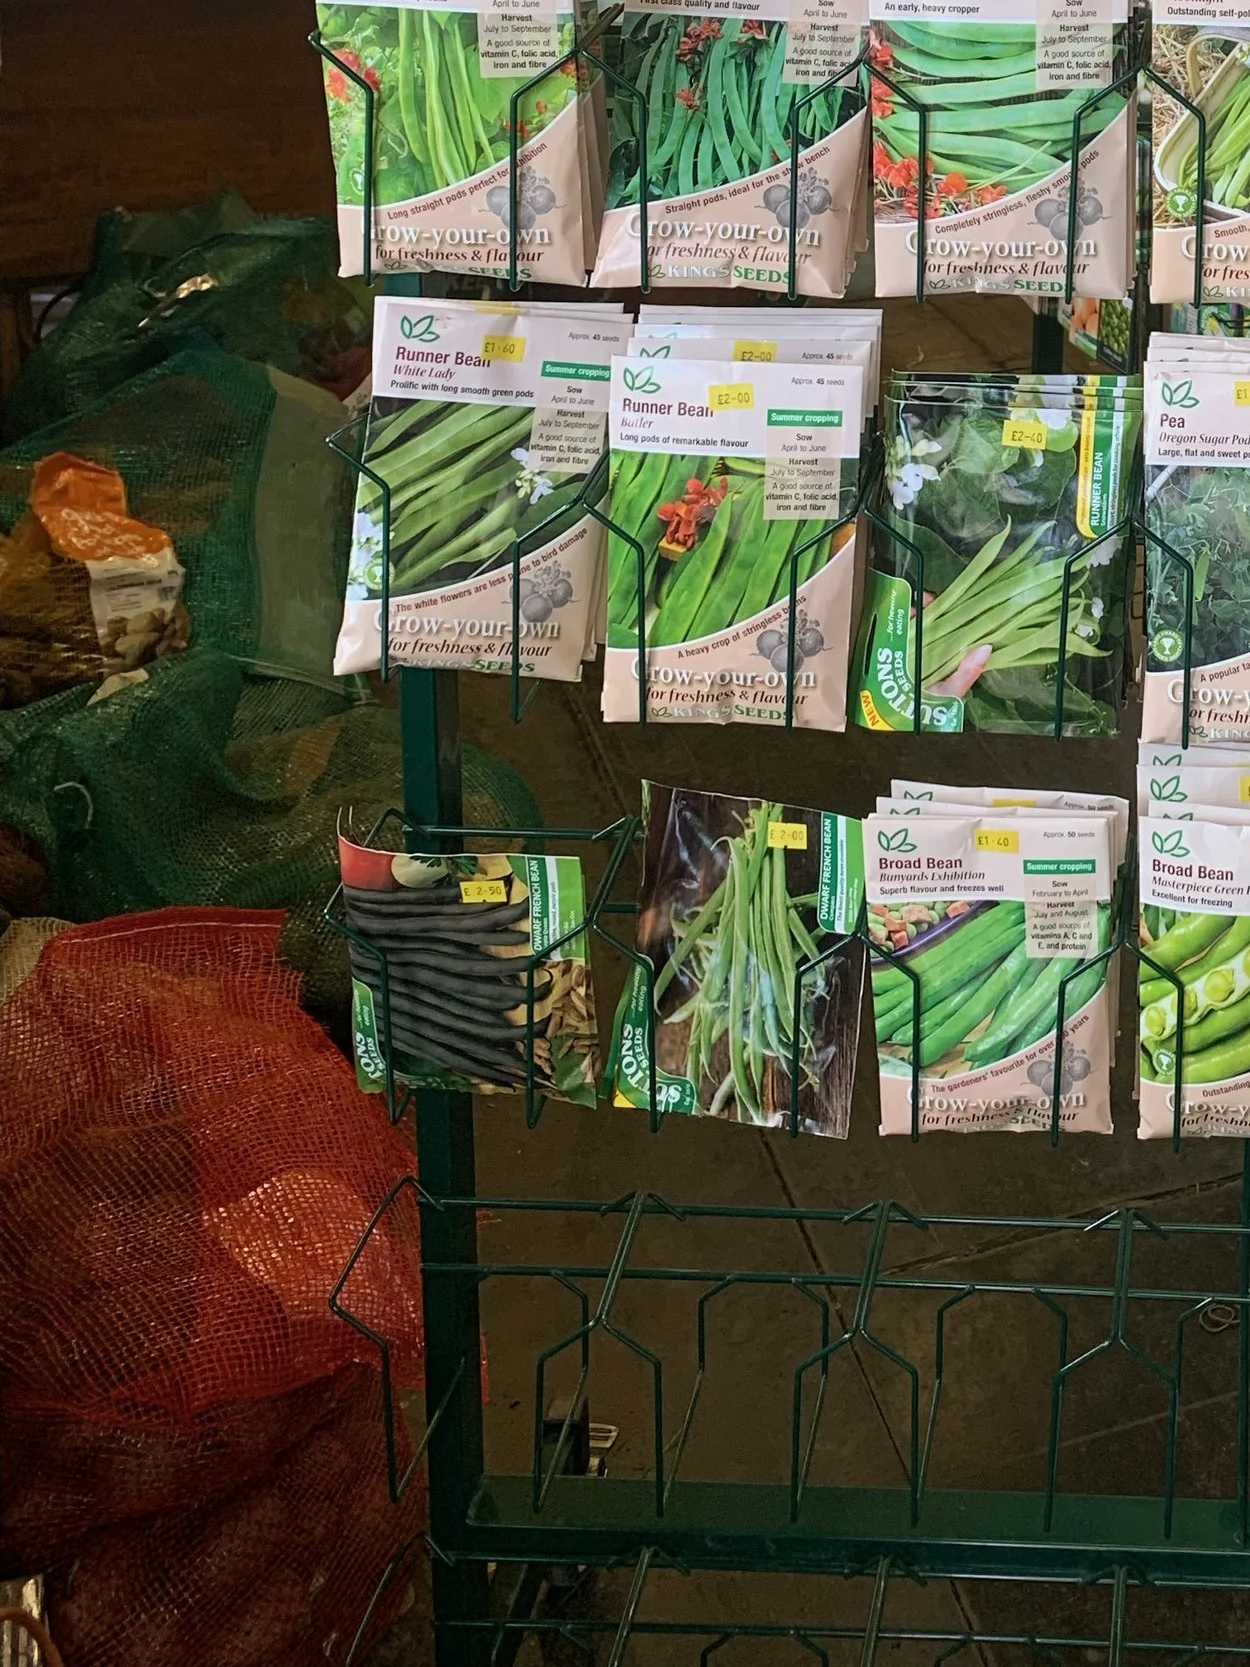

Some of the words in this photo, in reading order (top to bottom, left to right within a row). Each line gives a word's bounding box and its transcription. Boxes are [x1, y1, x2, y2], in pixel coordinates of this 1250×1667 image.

[484, 342, 515, 355] £1-60
[393, 364, 427, 377] White
[428, 367, 456, 382] Lady
[718, 392, 750, 405] £2-00
[1160, 413, 1185, 429] Pea
[1159, 431, 1192, 444] Oregon
[1196, 433, 1227, 446] Sugar
[1230, 433, 1250, 444] Pod
[1158, 447, 1183, 458] Large,
[1186, 448, 1199, 457] flat
[1201, 449, 1215, 458] and
[1217, 449, 1238, 459] sweet
[1093, 452, 1104, 481] BEAN
[1090, 482, 1102, 526] RUNNER
[824, 818, 832, 845] BEAN
[823, 845, 832, 882] FRENCH
[879, 857, 921, 871] Broad
[926, 856, 962, 869] Bean
[879, 871, 929, 883] Bunyards
[932, 869, 985, 881] Exhibition
[1152, 876, 1211, 893] Masterpiece
[1214, 881, 1243, 894] Green
[820, 882, 830, 920] DWARF
